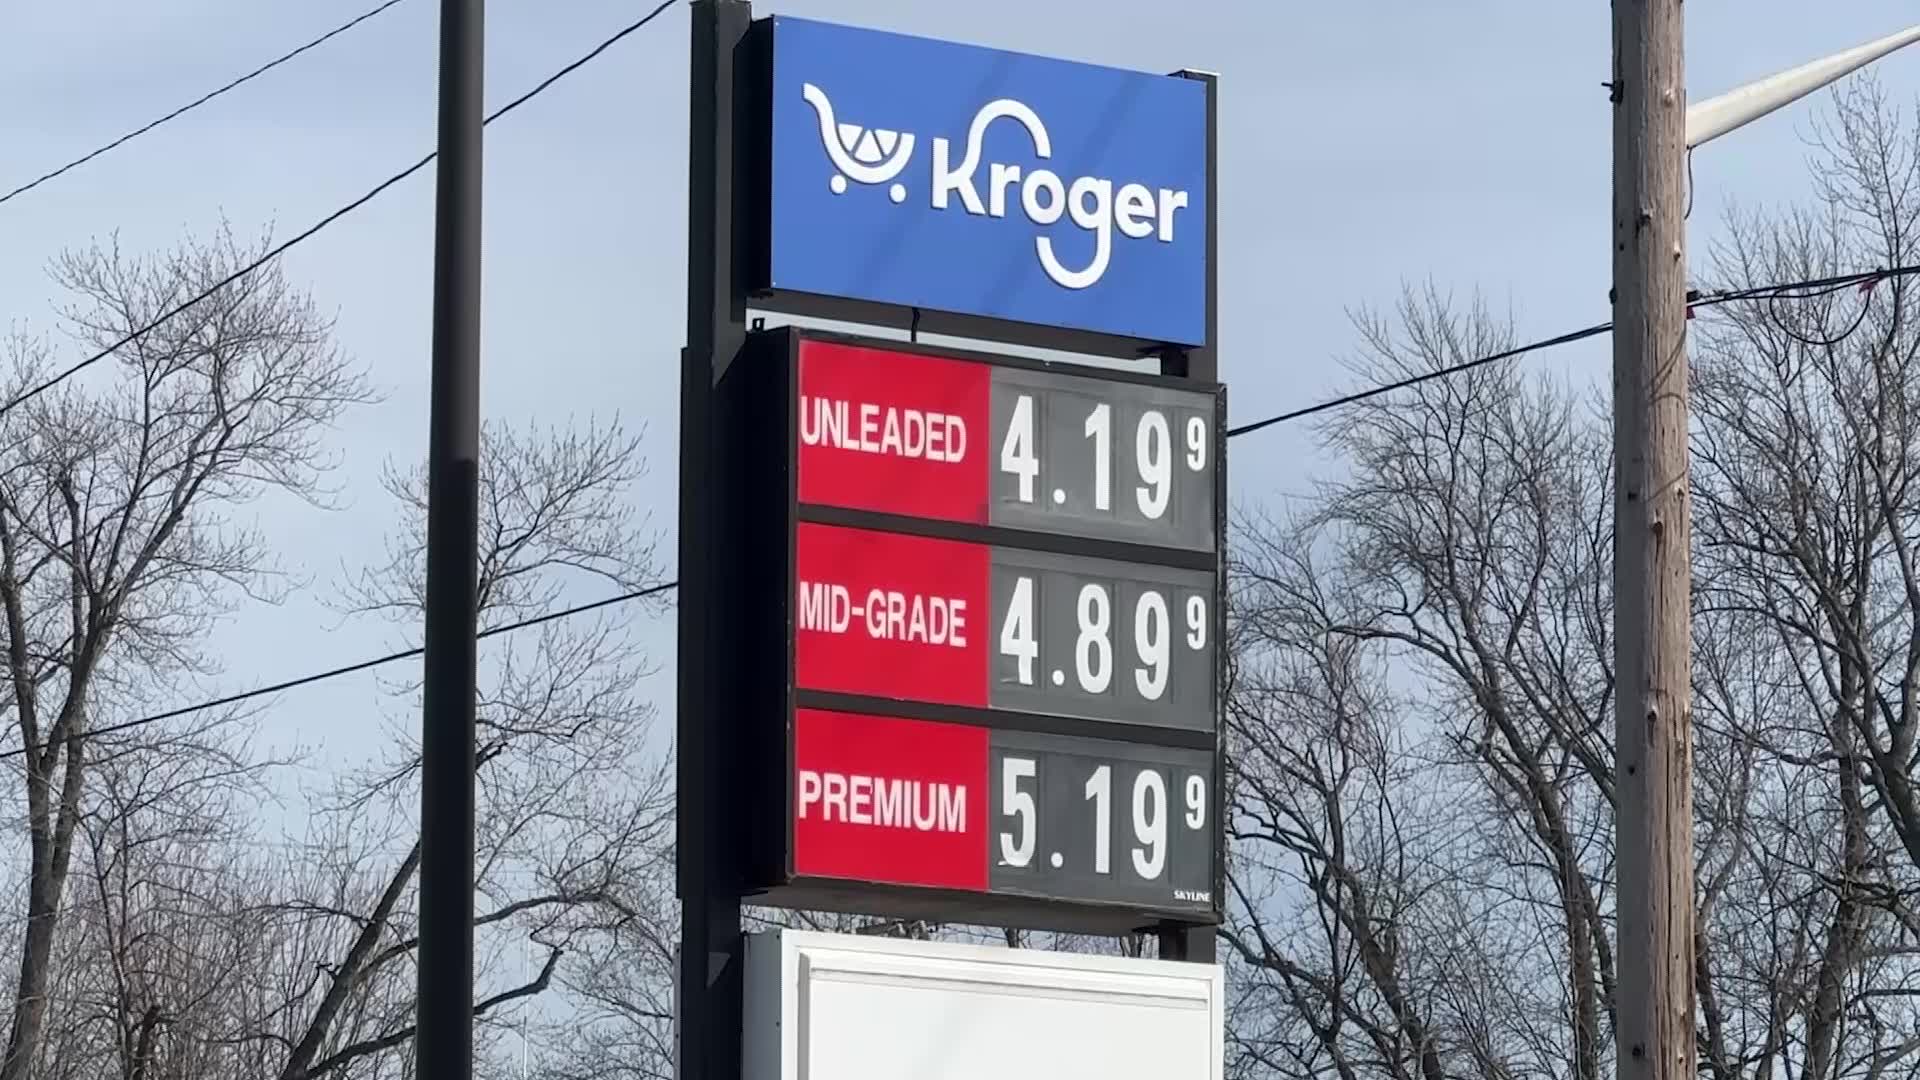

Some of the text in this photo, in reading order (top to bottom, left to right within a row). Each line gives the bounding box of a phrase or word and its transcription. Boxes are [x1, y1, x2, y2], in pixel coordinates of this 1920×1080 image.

[931, 98, 1189, 289] Kroger
[801, 396, 967, 463] UNLEADED
[799, 581, 967, 648] MID-GRADE
[798, 770, 967, 833] PREMIUM
[1174, 890, 1211, 902] SKYLINE
